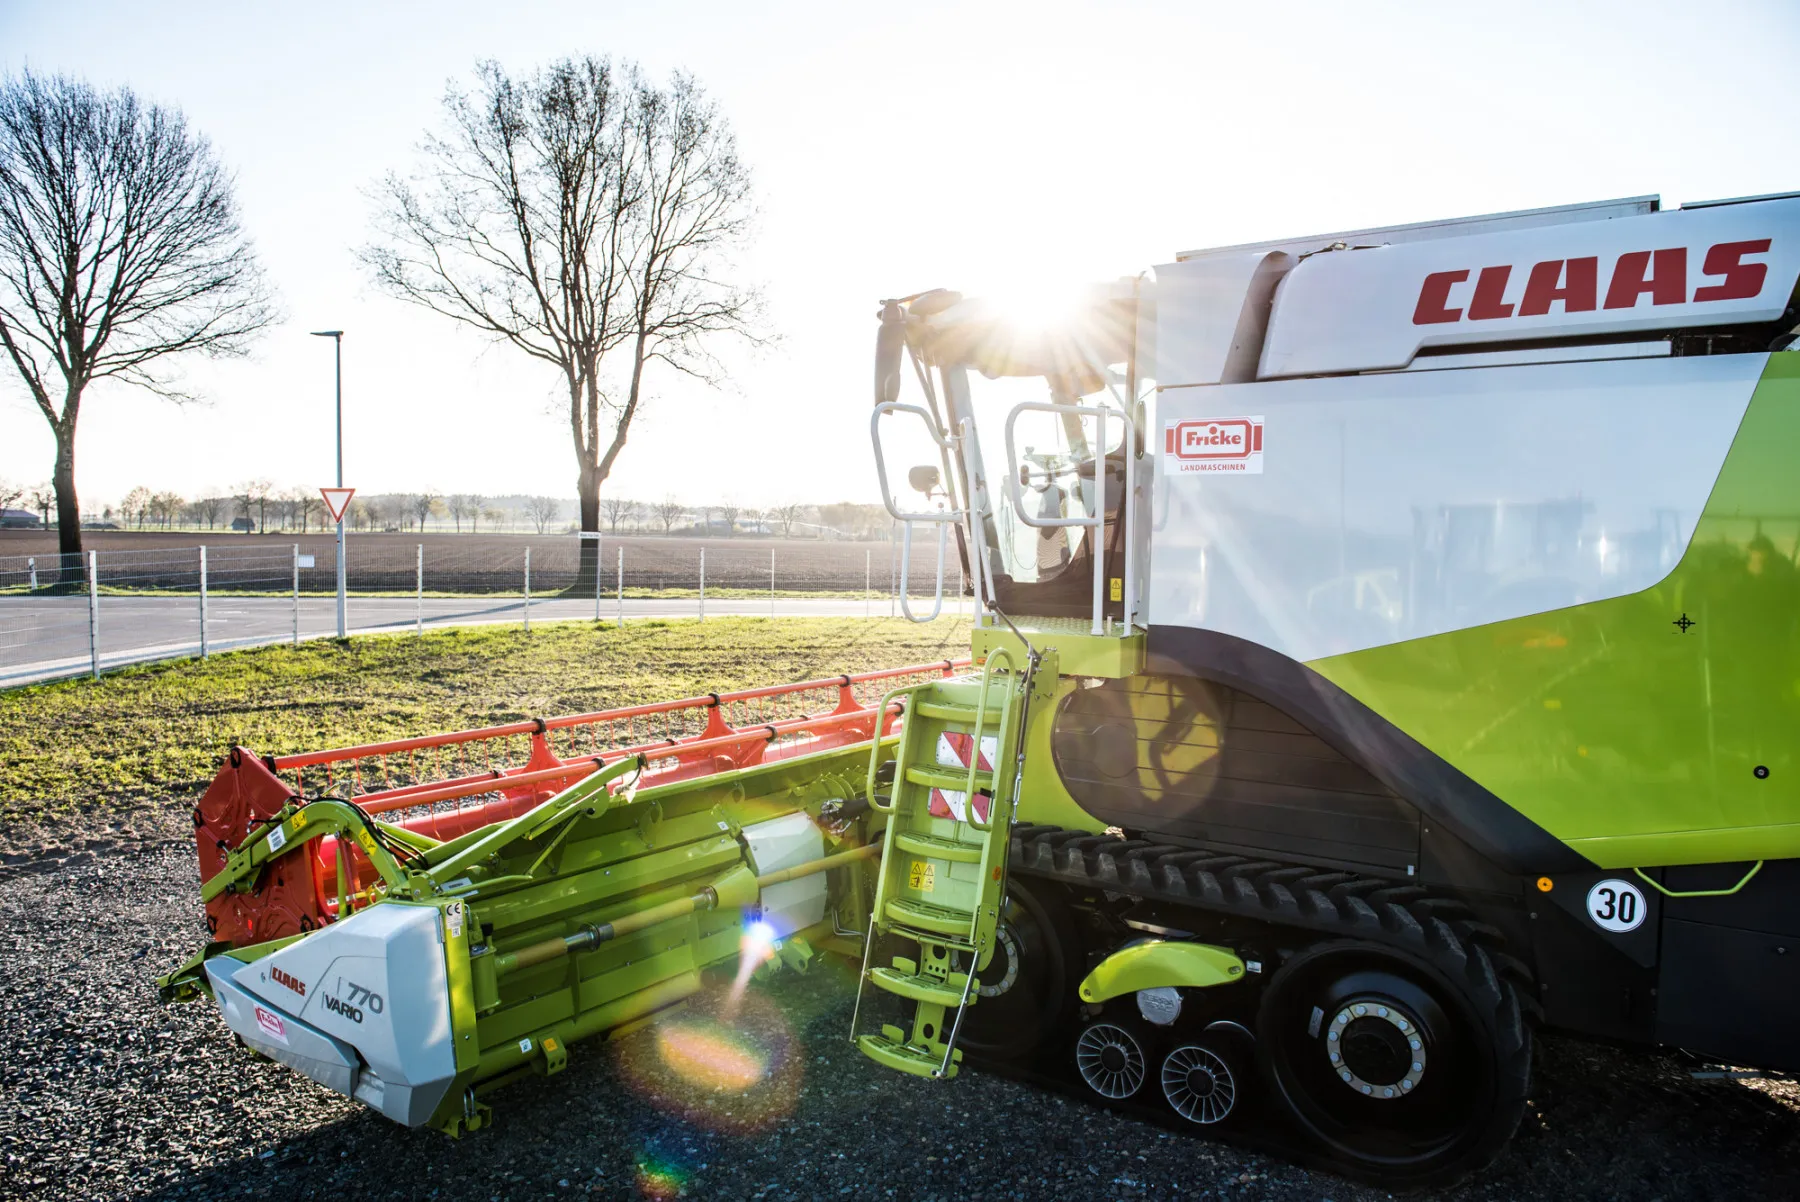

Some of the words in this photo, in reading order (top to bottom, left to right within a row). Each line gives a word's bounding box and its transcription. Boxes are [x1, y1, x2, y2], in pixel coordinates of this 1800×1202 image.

[1412, 238, 1773, 325] CLAAS
[1186, 426, 1242, 446] Fricke
[1180, 463, 1246, 472] LANDMASCHINEN
[1596, 887, 1636, 924] 30
[271, 966, 306, 997] CLAAS
[325, 994, 364, 1024] VARIO
[348, 981, 384, 1015] 770
